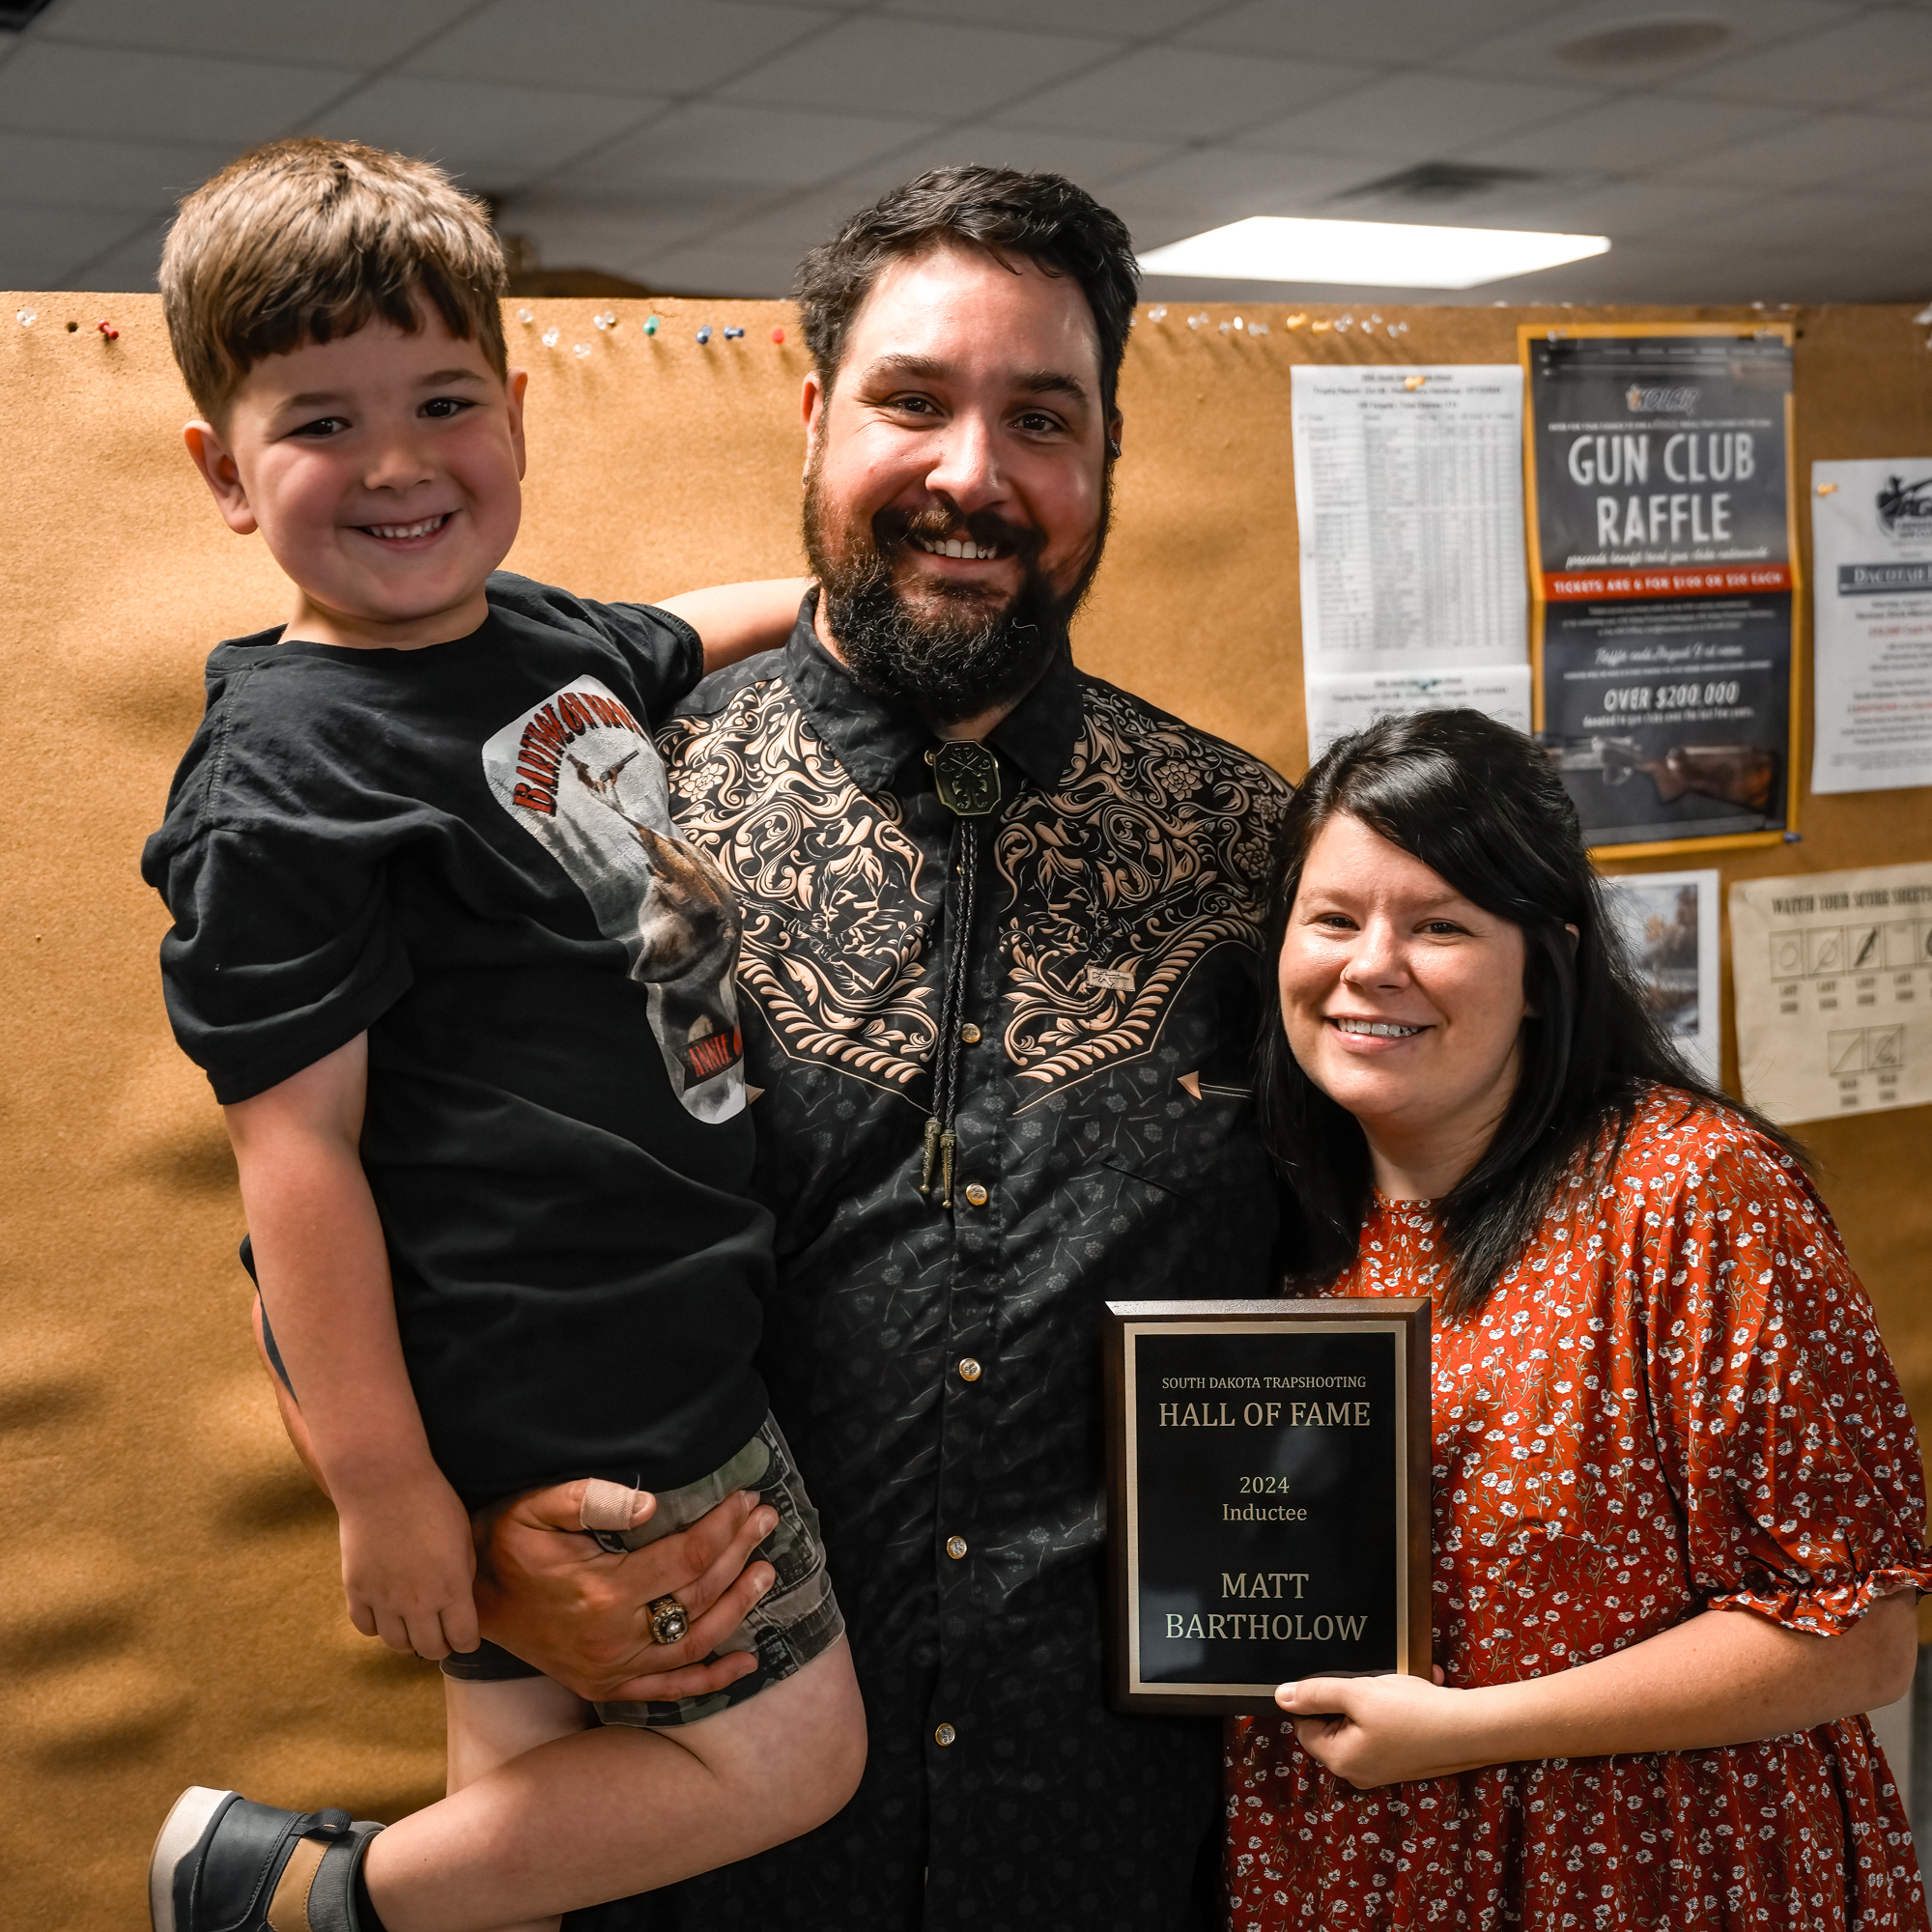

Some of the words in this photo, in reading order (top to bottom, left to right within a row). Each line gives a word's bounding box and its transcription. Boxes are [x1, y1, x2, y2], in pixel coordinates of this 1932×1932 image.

[1568, 435, 1649, 486] GUN
[1663, 433, 1755, 483] CLUB
[1596, 492, 1731, 548] RAFFLE
[1553, 580, 1604, 594] TICKETS
[1606, 579, 1632, 591] ARE
[1644, 577, 1669, 590] FOR
[1705, 574, 1723, 587] OR
[1750, 572, 1783, 585] EACH
[1604, 686, 1651, 713] OVER
[1818, 893, 1849, 910] YOUR
[1162, 1377, 1206, 1389] SOUTH
[1208, 1377, 1262, 1389] DAKOTA
[1264, 1376, 1367, 1389] TRAPSHOOTING
[1159, 1402, 1236, 1427] HALL
[1243, 1402, 1282, 1427] OF
[1291, 1402, 1371, 1427] FAME
[1239, 1476, 1290, 1494] 2024
[1222, 1503, 1308, 1521] Inductee
[1221, 1573, 1309, 1599] MATT
[1165, 1613, 1368, 1641] BARTHOLOW
